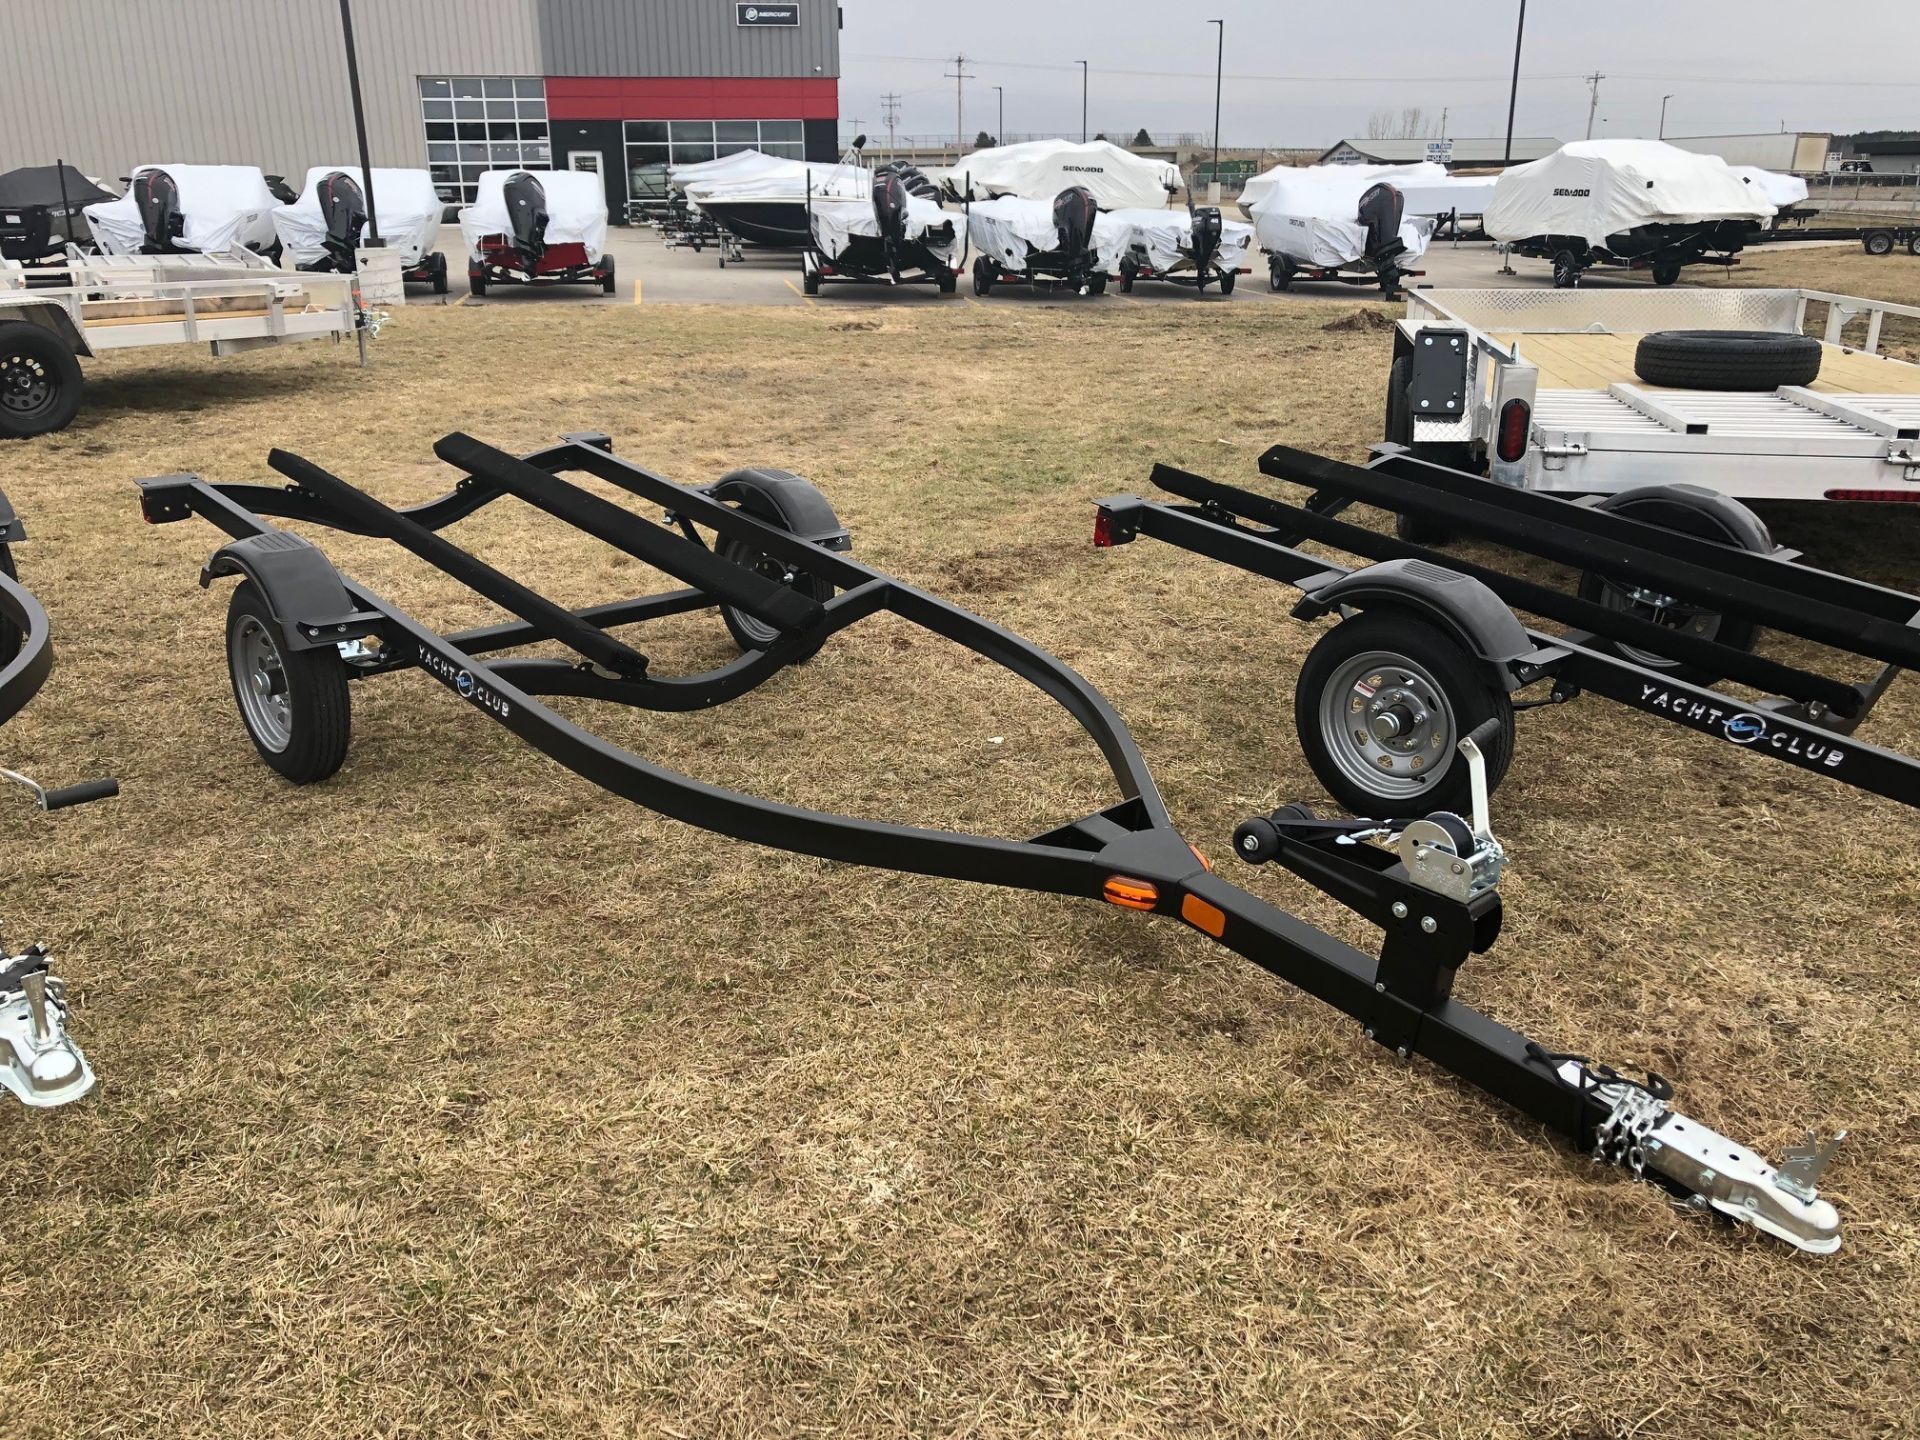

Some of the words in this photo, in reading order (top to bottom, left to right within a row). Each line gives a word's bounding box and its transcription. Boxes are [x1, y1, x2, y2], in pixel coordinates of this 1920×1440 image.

[418, 644, 455, 681] YACHT
[477, 686, 510, 718] CLUB
[1640, 684, 1724, 725] YACHT
[1770, 731, 1845, 768] CLUB
